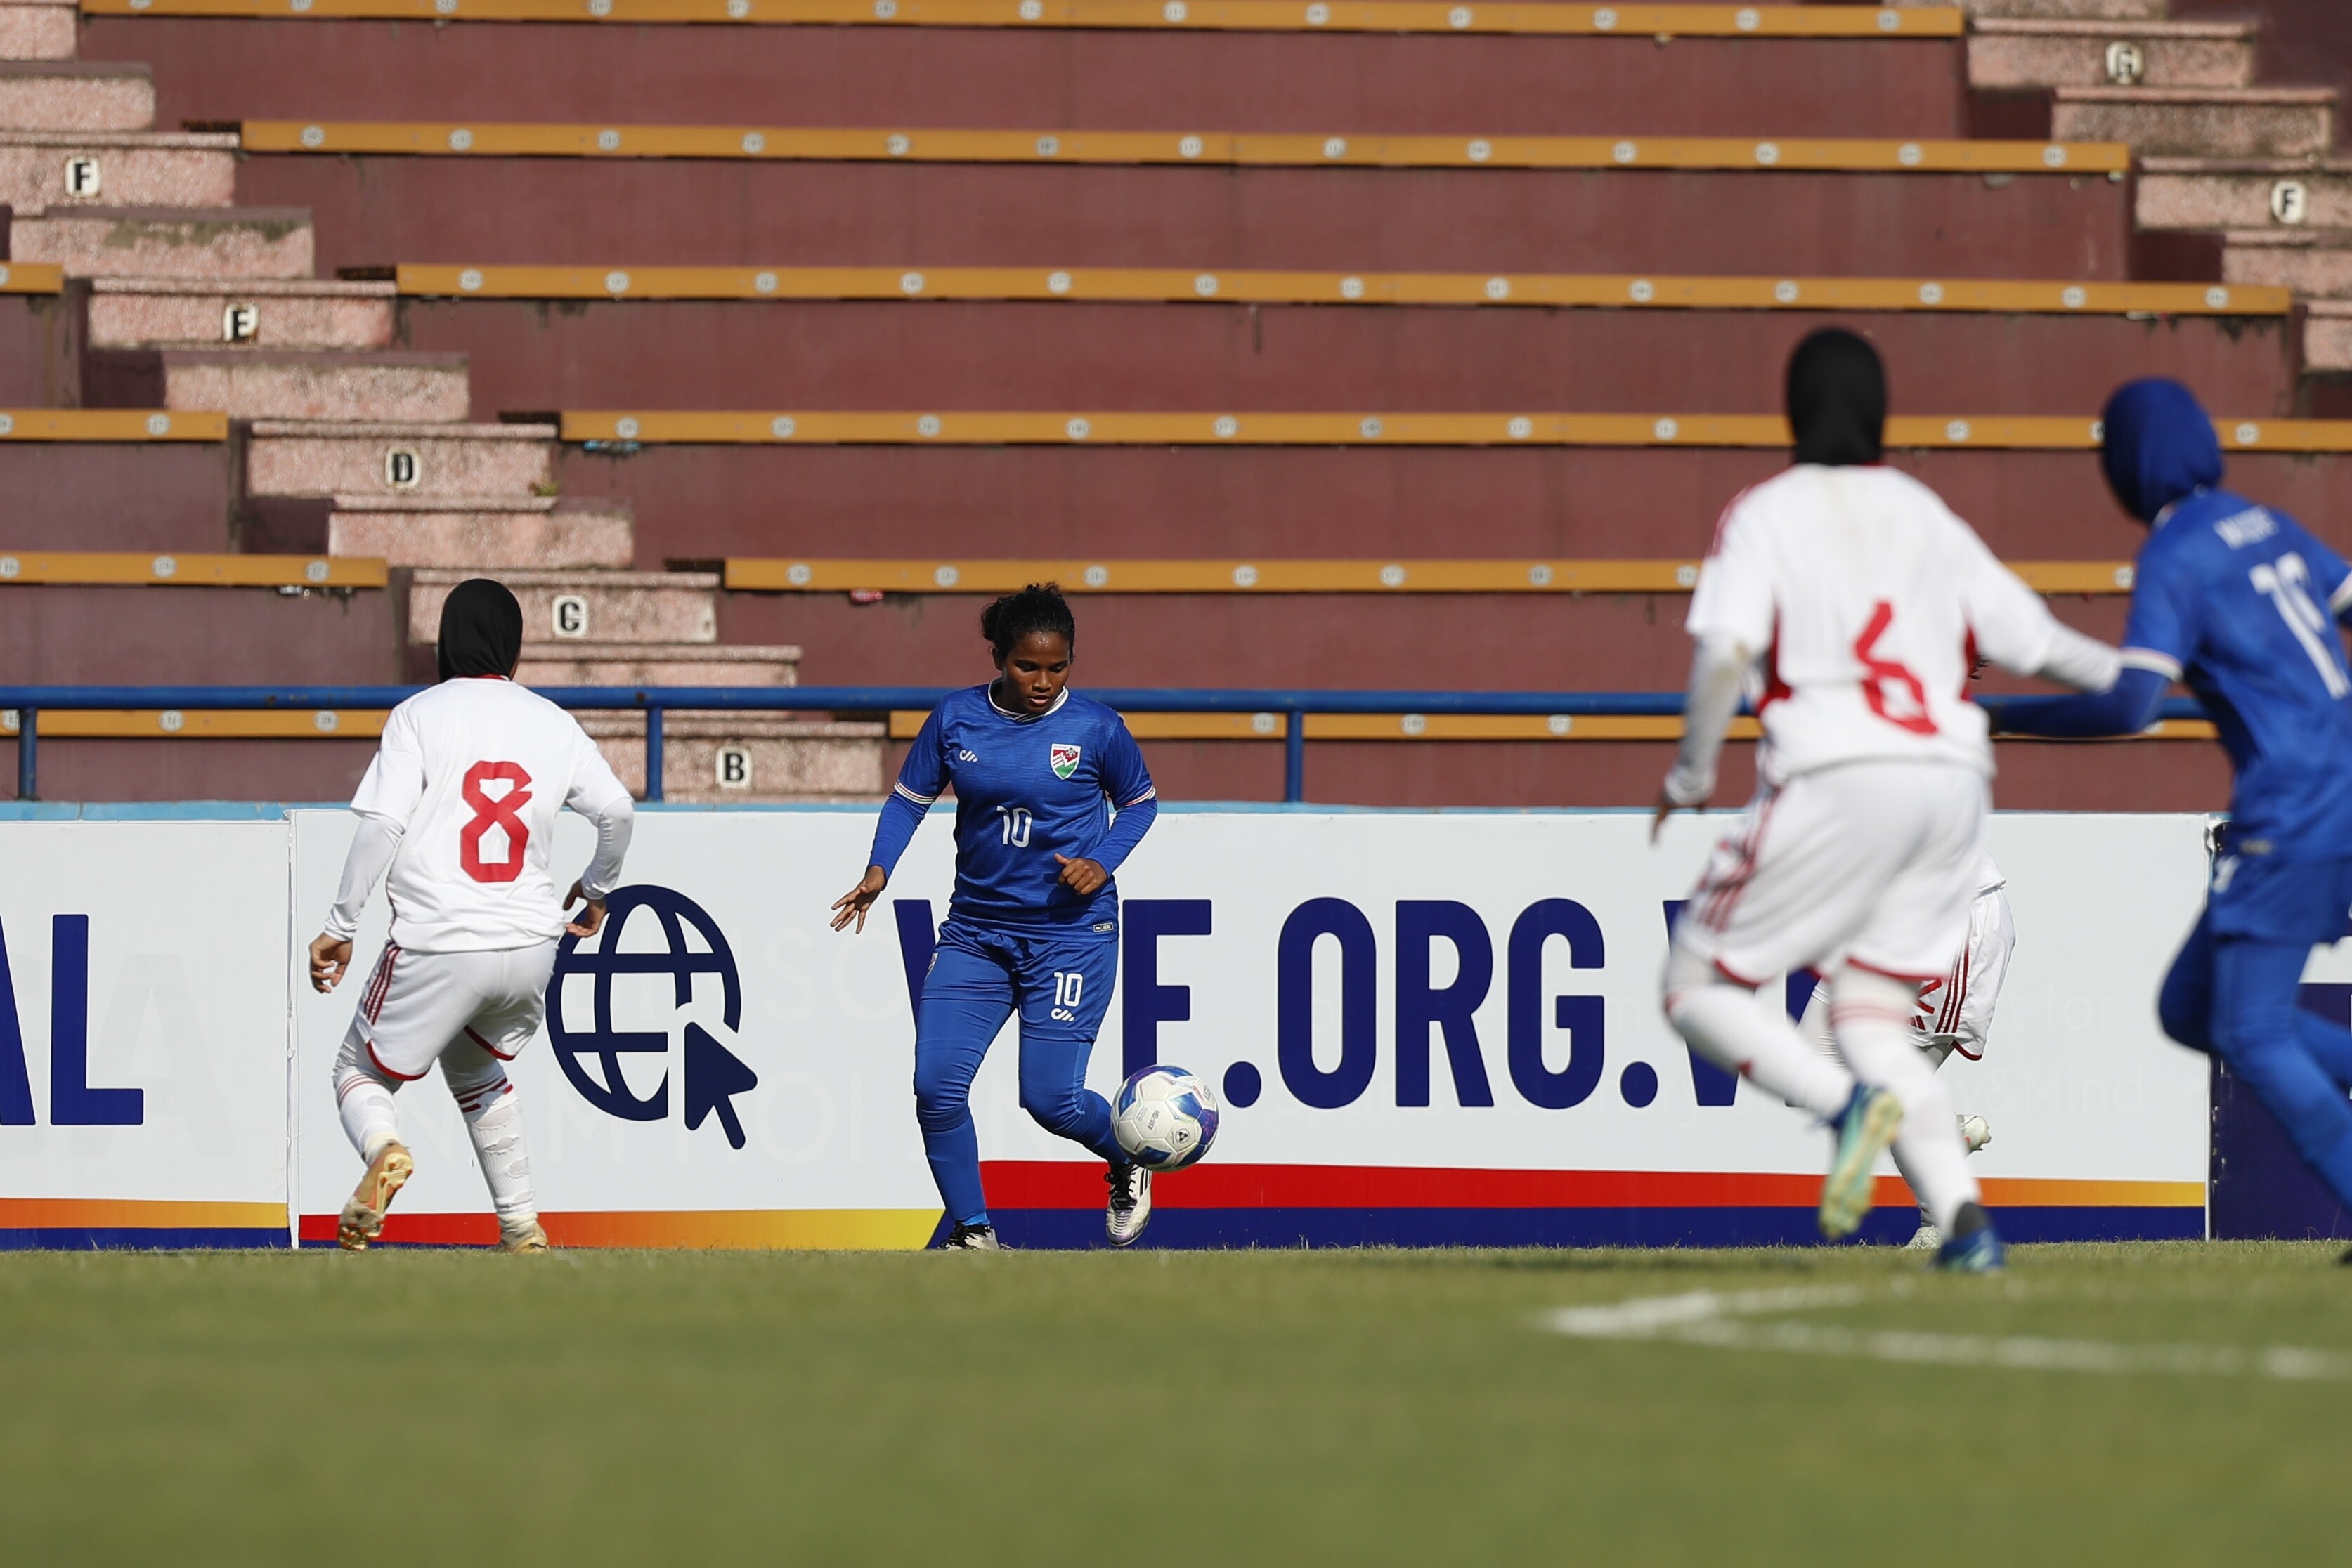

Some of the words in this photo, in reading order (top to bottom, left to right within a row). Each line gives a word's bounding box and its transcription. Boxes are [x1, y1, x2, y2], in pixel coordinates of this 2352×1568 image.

[73, 162, 91, 191] F
[2281, 188, 2296, 216] F
[232, 309, 255, 341] E
[391, 452, 414, 483] D
[1854, 602, 1937, 734] 6
[724, 751, 745, 782] B
[460, 760, 533, 884] 8
[996, 804, 1033, 849] 10
[1053, 971, 1084, 1007] 10
